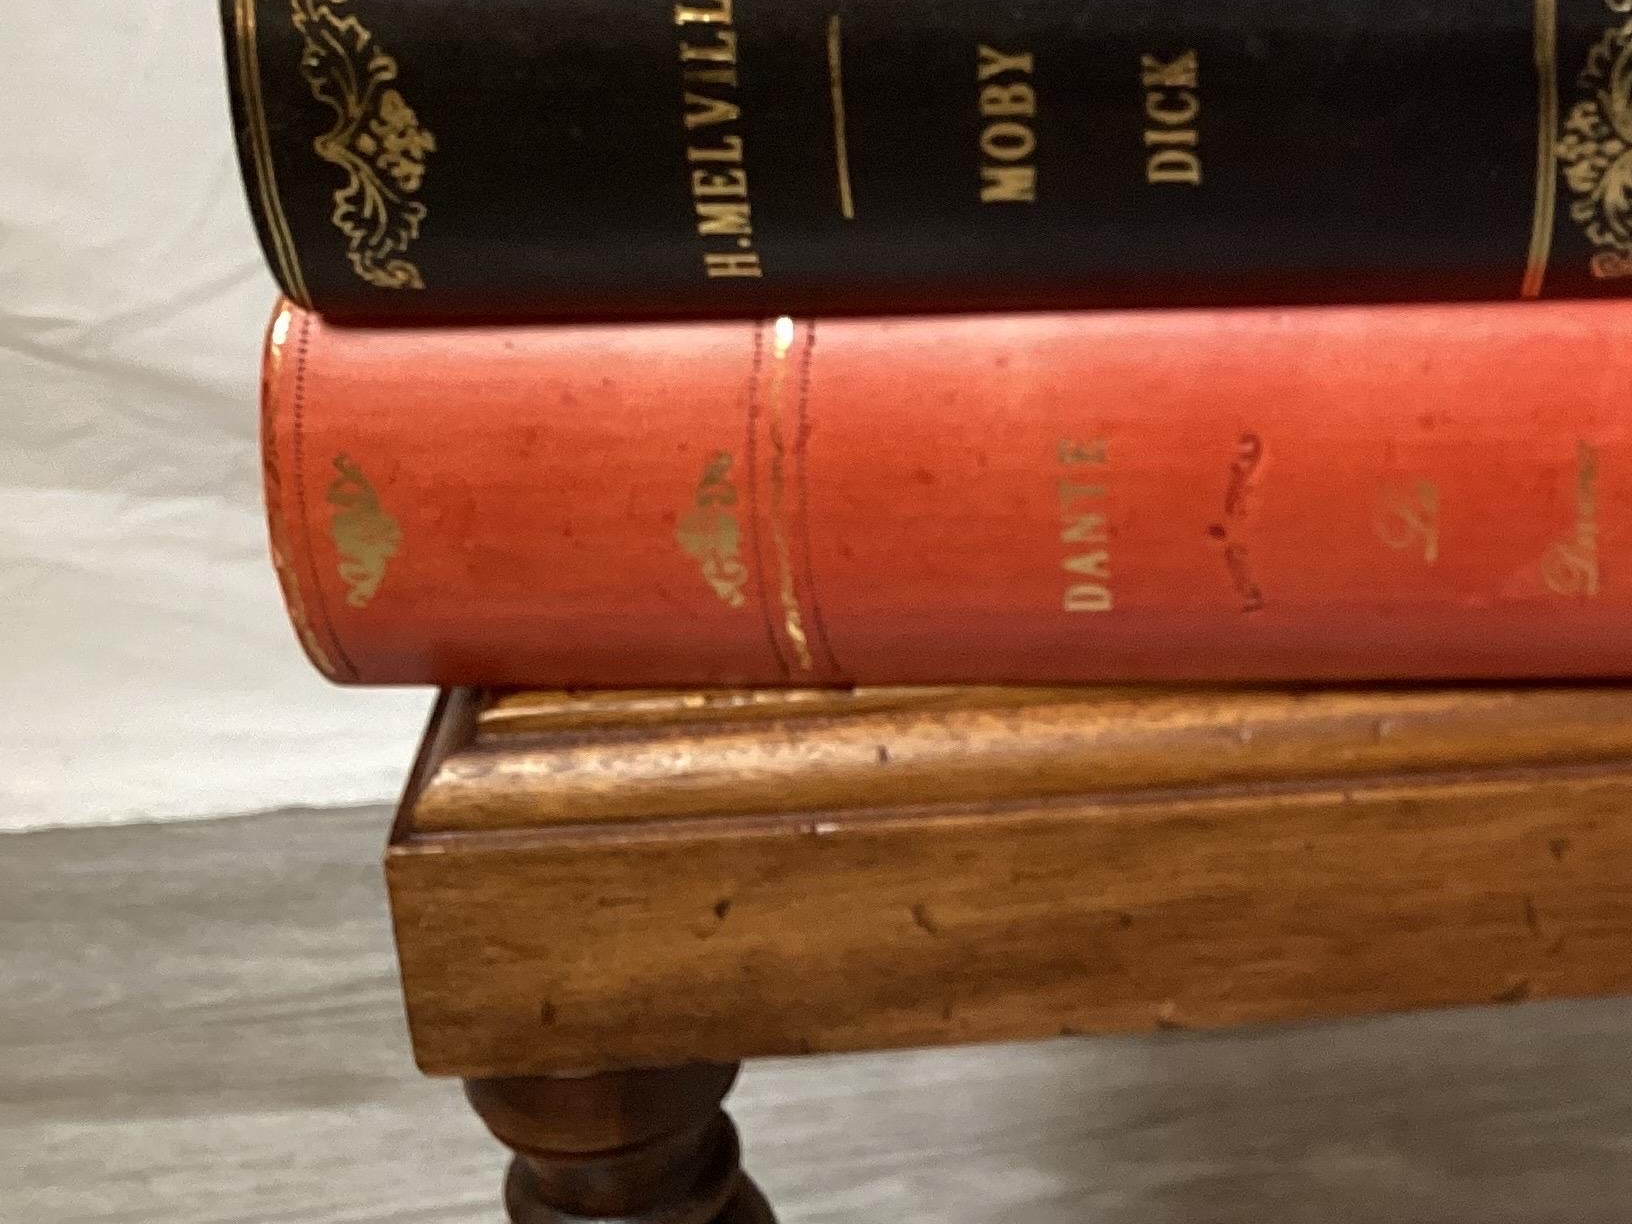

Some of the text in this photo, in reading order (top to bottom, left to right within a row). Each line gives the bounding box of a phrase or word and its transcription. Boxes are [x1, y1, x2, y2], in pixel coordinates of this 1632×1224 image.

[977, 44, 1037, 204] MOBY
[1140, 48, 1201, 186] DICK
[1056, 434, 1113, 613] DANTE
